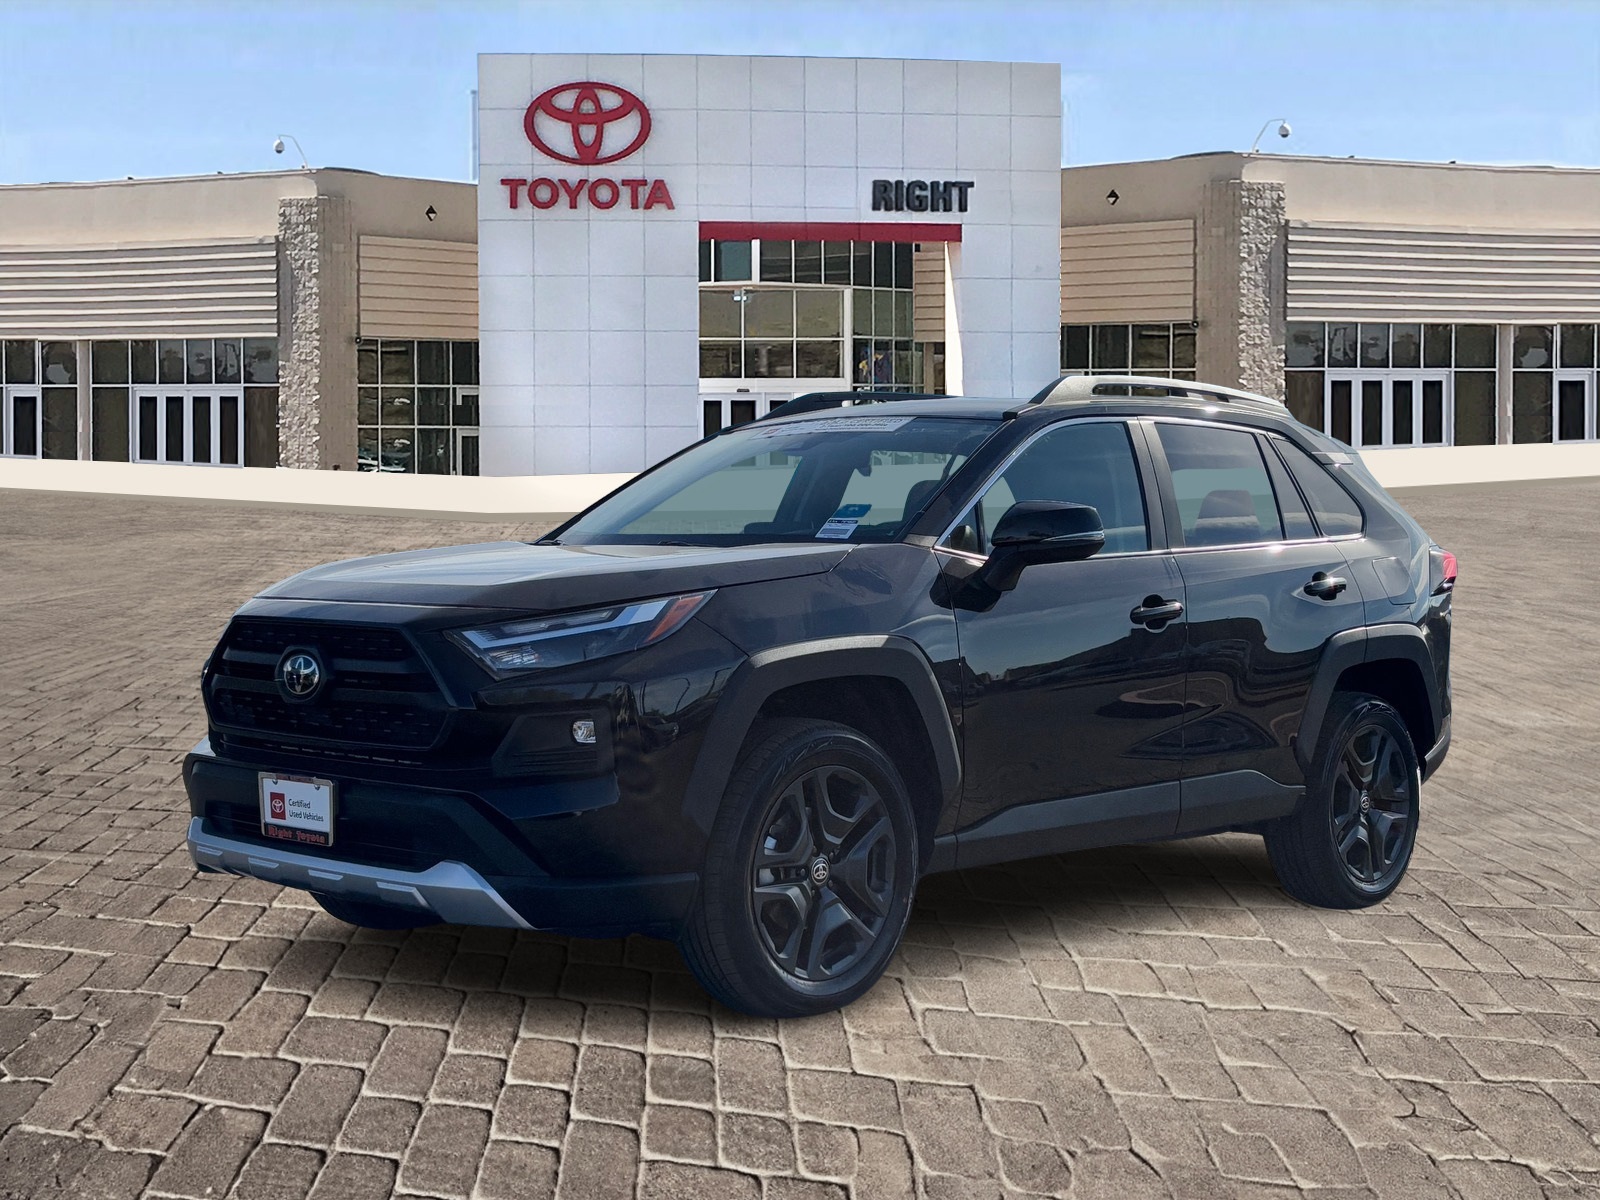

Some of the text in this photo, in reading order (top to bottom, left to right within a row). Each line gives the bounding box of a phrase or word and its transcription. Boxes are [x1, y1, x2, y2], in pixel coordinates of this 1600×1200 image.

[500, 177, 675, 210] TOYOTA
[872, 179, 975, 212] RIGHT
[288, 798, 311, 809] Certified
[288, 810, 324, 822] Used Vehicles
[268, 824, 326, 844] Right Toyota
